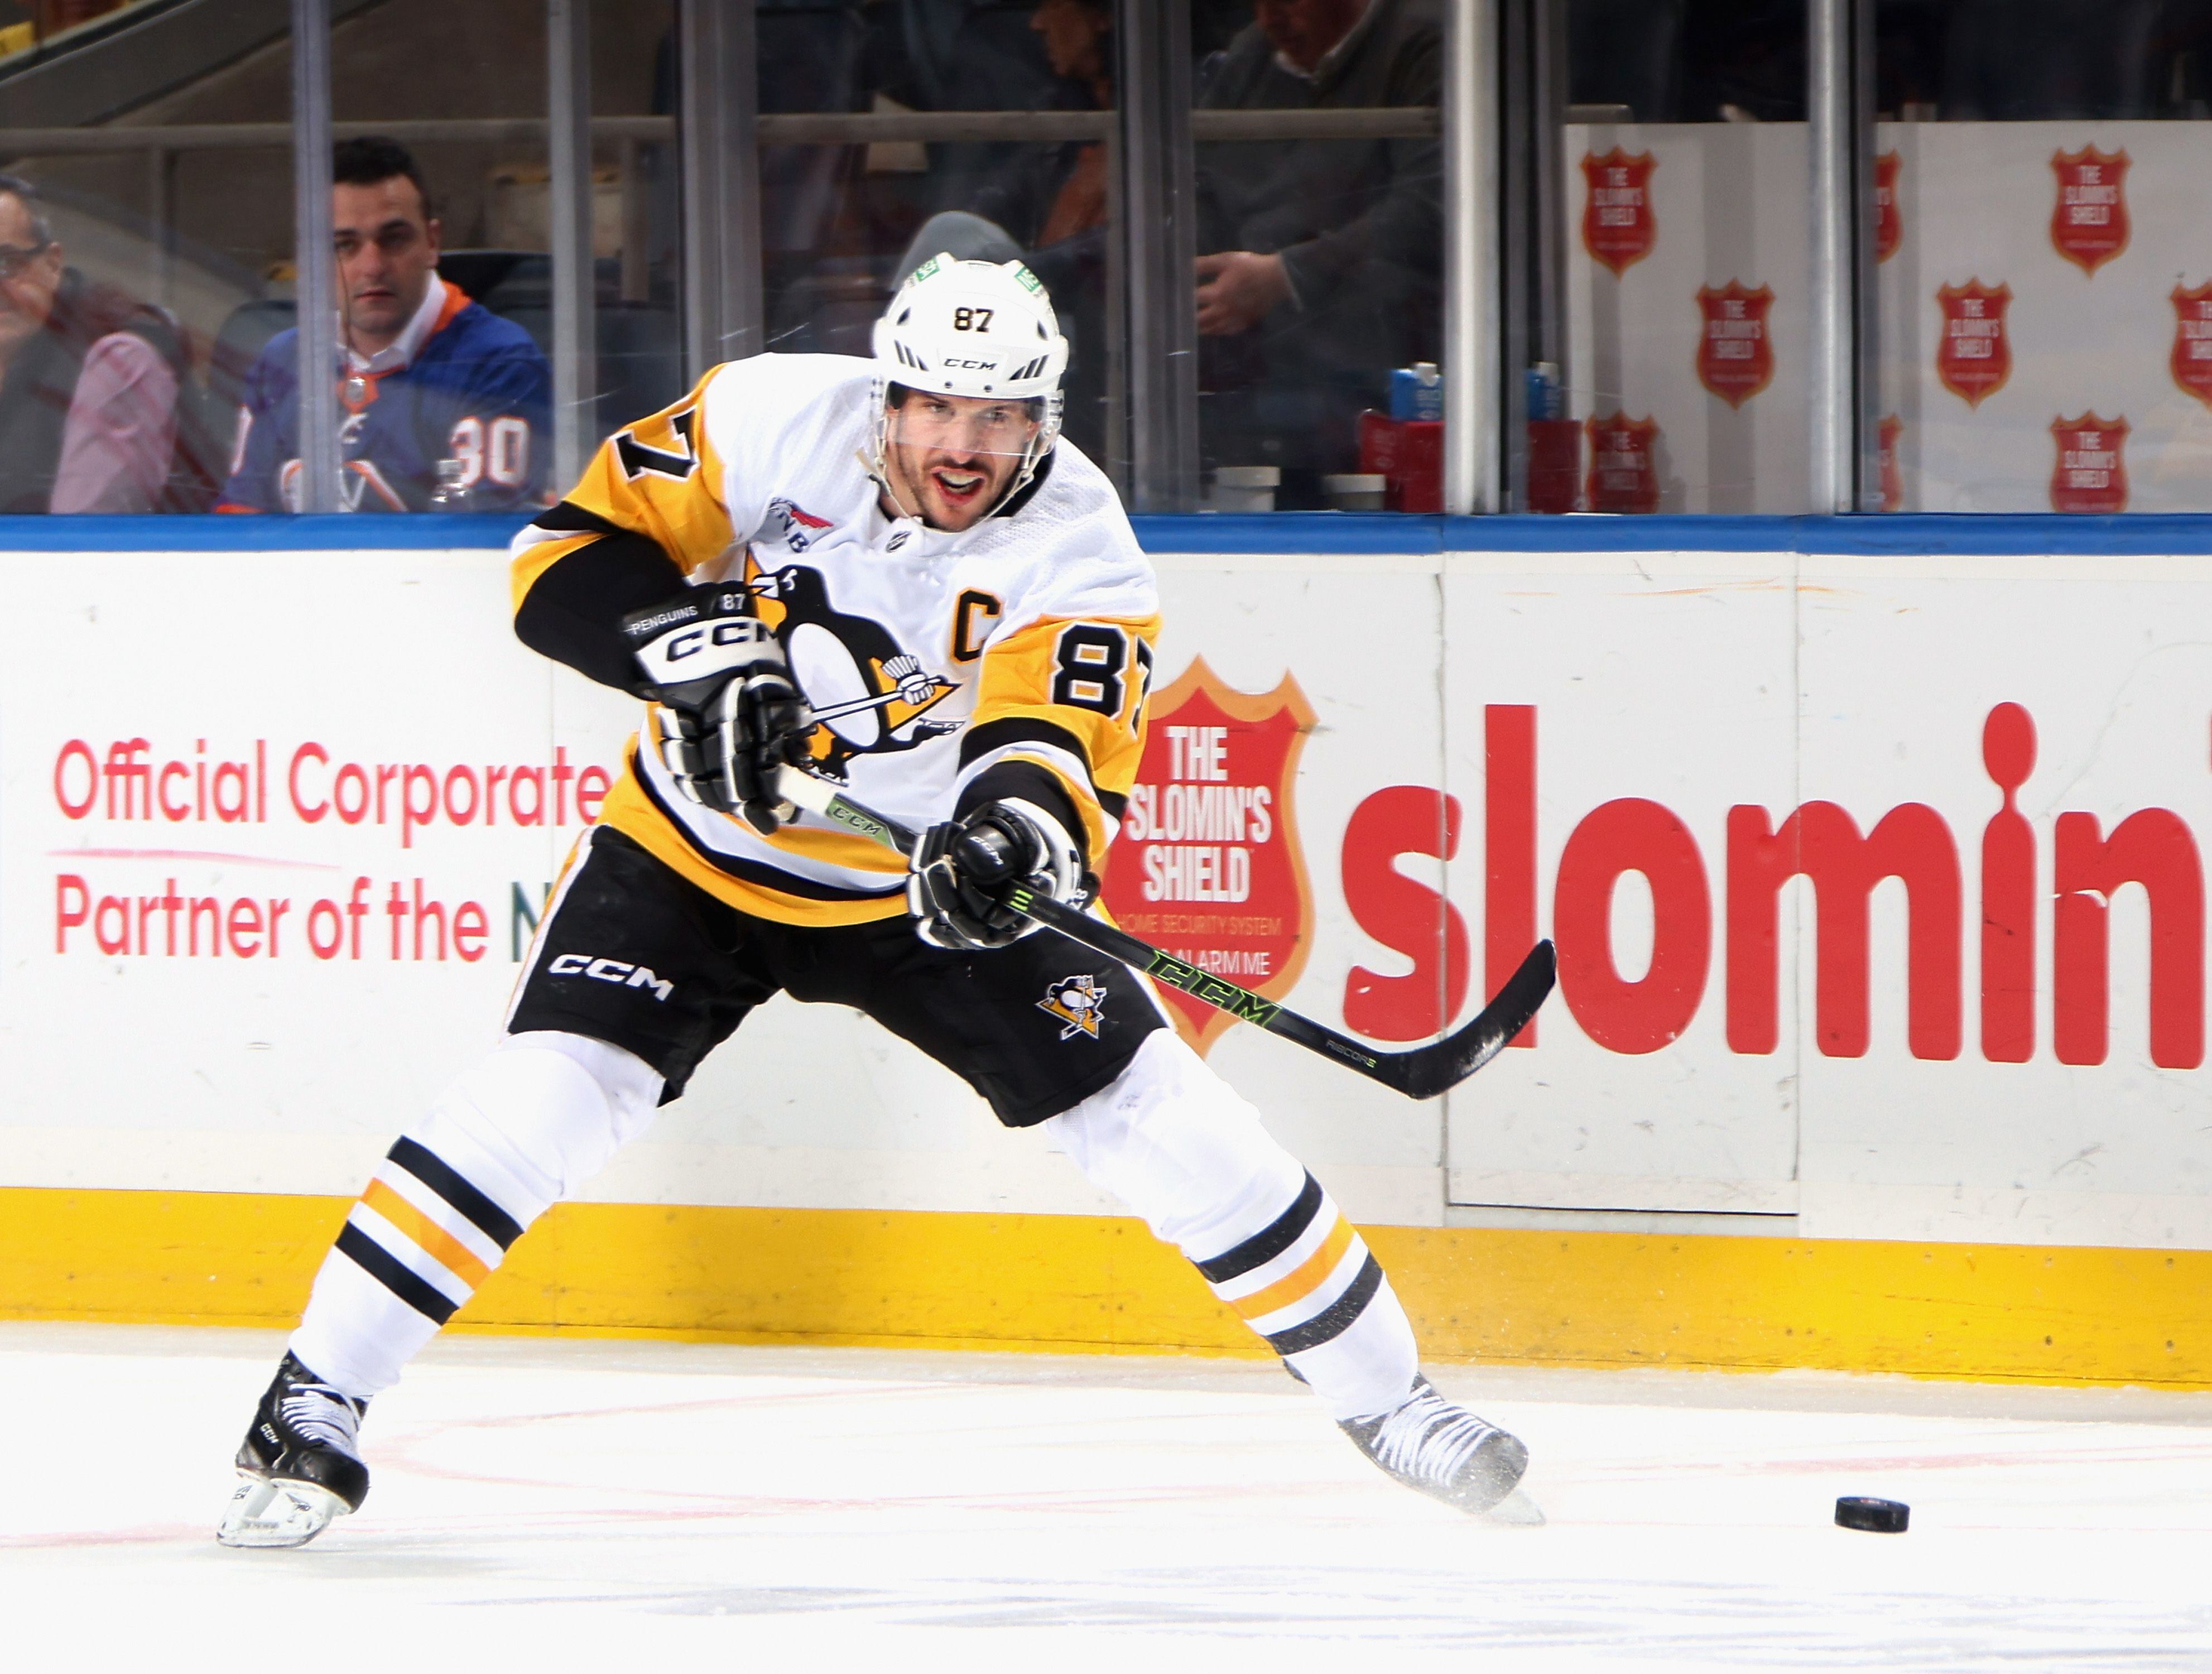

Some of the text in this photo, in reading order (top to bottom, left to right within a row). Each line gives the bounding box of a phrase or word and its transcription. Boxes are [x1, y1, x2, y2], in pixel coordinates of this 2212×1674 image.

[954, 307, 994, 333] 87
[943, 358, 998, 371] CCM
[629, 593, 747, 634] PENGUINS 87
[951, 586, 1002, 665] C
[1165, 725, 1228, 781] THE
[53, 737, 613, 849] Official Corporate
[1126, 782, 1273, 843] SLOMIN'S
[833, 806, 881, 835] CCM
[1142, 843, 1251, 902] SHIELD
[55, 873, 290, 959] Partner
[307, 876, 369, 961] of
[387, 878, 489, 963] the
[1162, 914, 1227, 935] SECURITY
[1229, 916, 1282, 936] SYSTEM
[547, 953, 675, 1002] CCM
[1145, 949, 1283, 1028] CCM
[1243, 951, 1271, 976] ME
